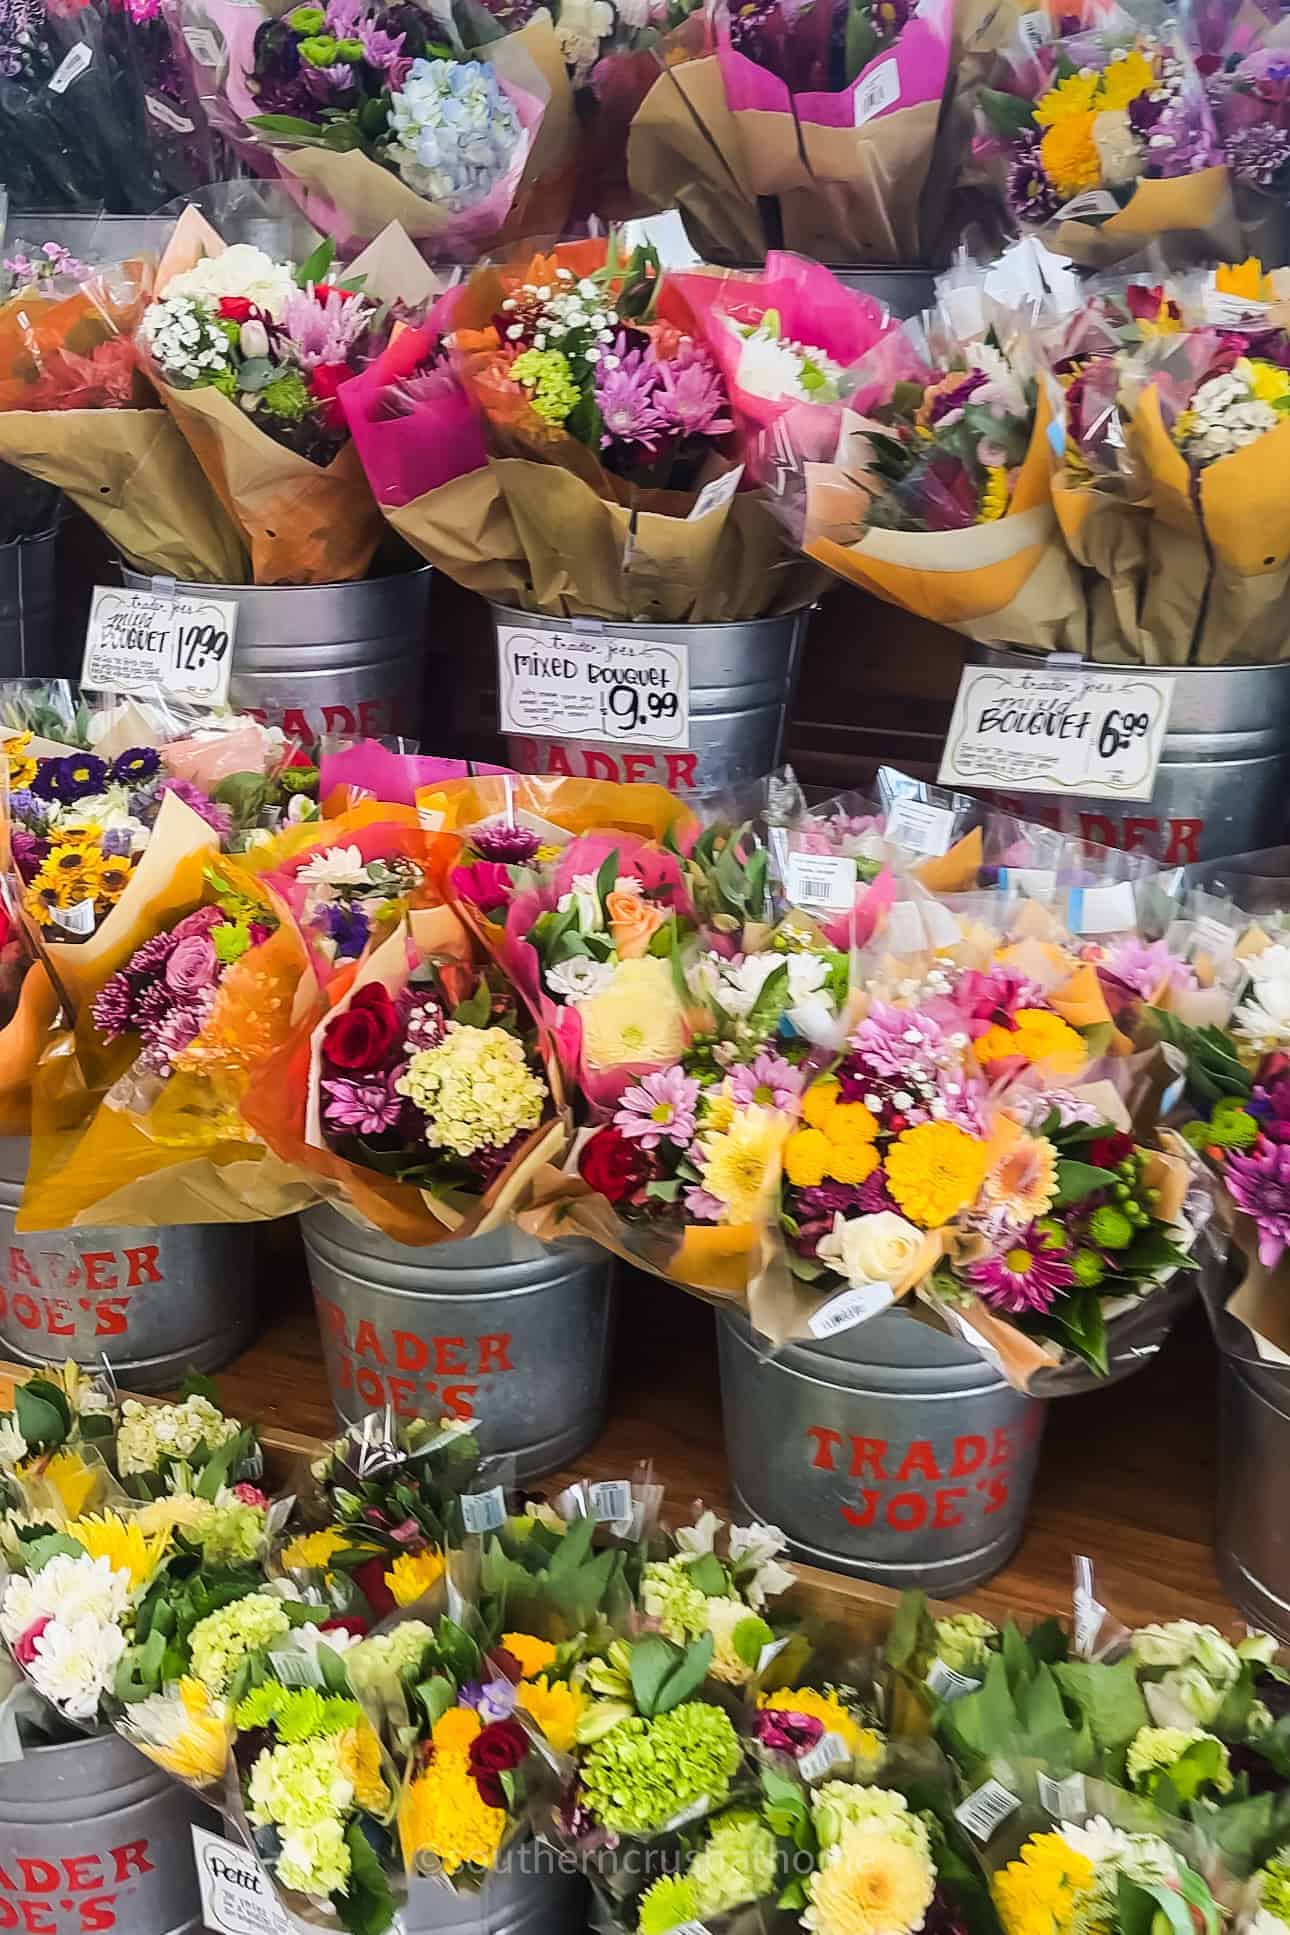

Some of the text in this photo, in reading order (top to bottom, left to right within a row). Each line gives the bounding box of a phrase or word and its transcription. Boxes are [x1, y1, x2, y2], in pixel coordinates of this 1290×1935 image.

[176, 624, 229, 671] 12.99
[1099, 710, 1149, 758] 6.99
[839, 1475, 1009, 1532] JOE'S
